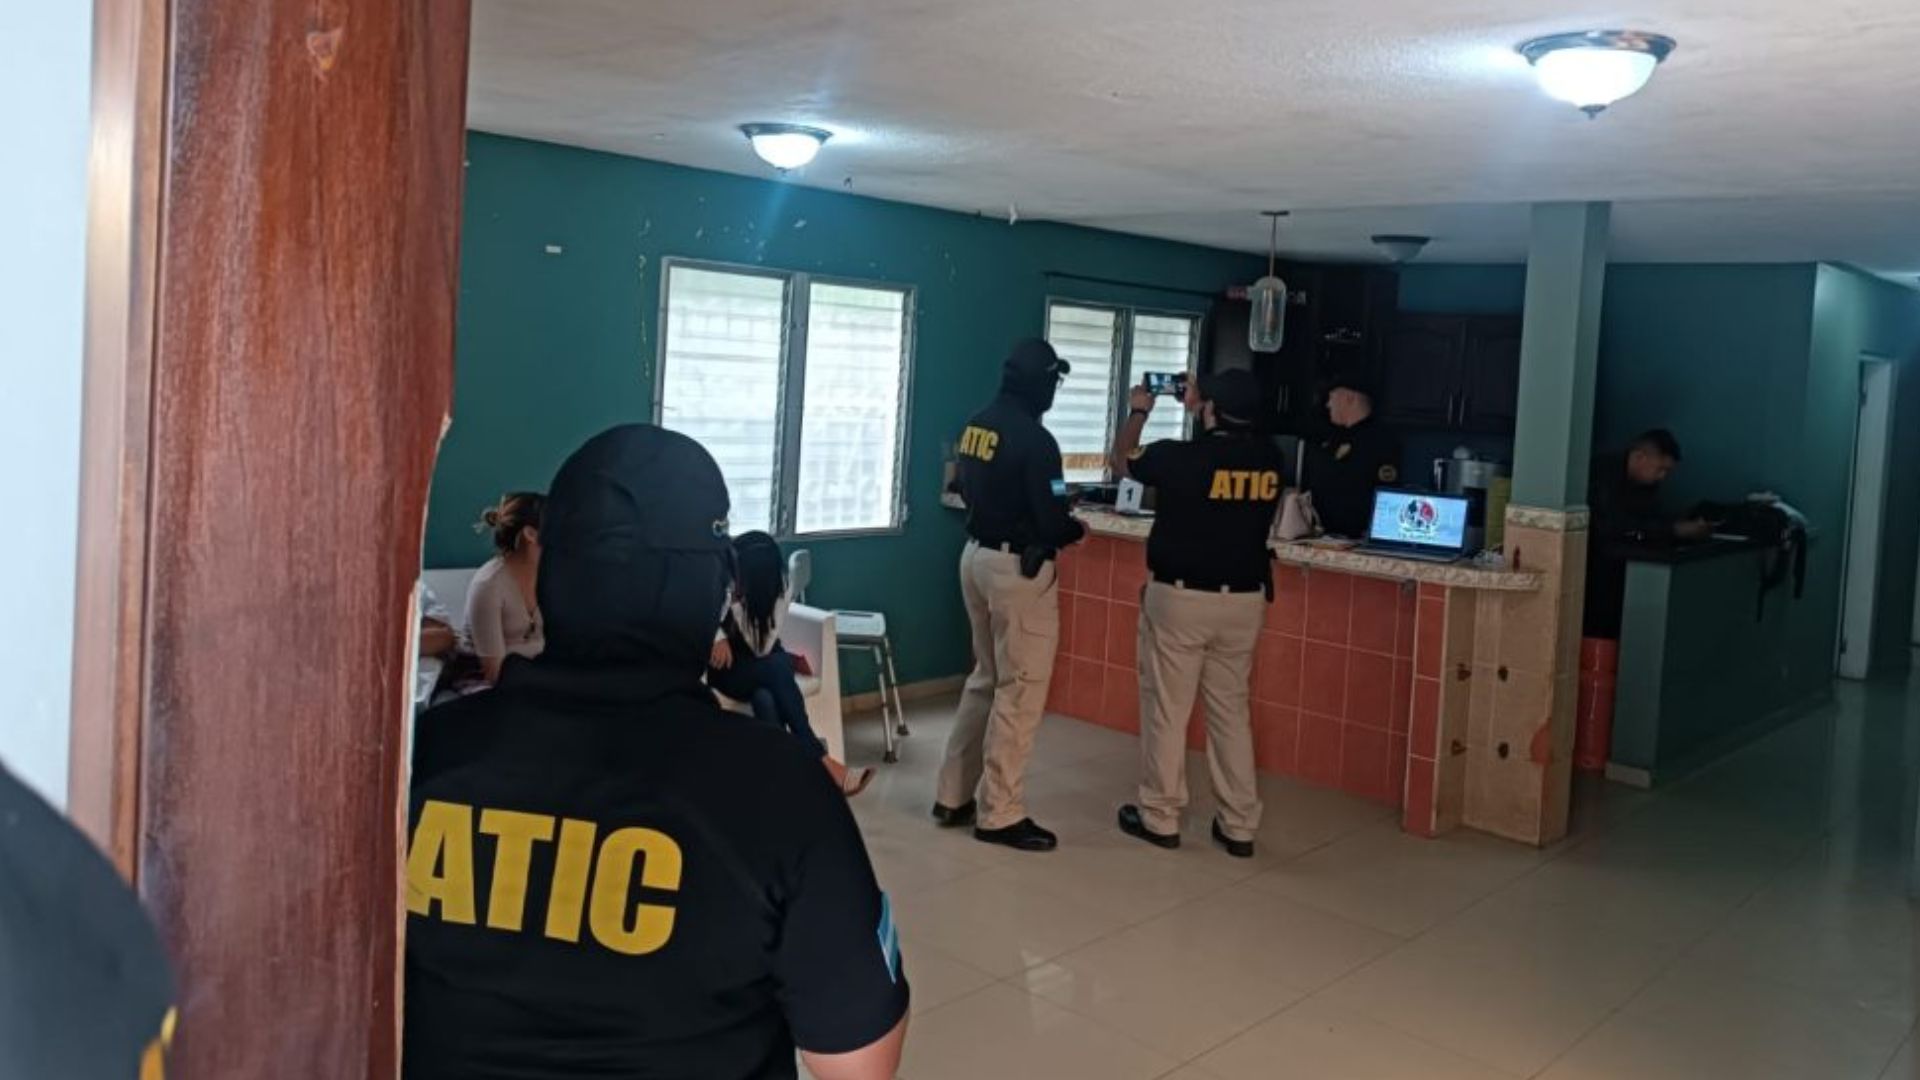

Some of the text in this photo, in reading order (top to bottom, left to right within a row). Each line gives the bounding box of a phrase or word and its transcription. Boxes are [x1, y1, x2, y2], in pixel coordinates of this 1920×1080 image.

[959, 425, 999, 461] ATIC
[1126, 487, 1134, 502] 1
[1209, 469, 1278, 501] ATIC
[407, 800, 683, 955] ATIC
